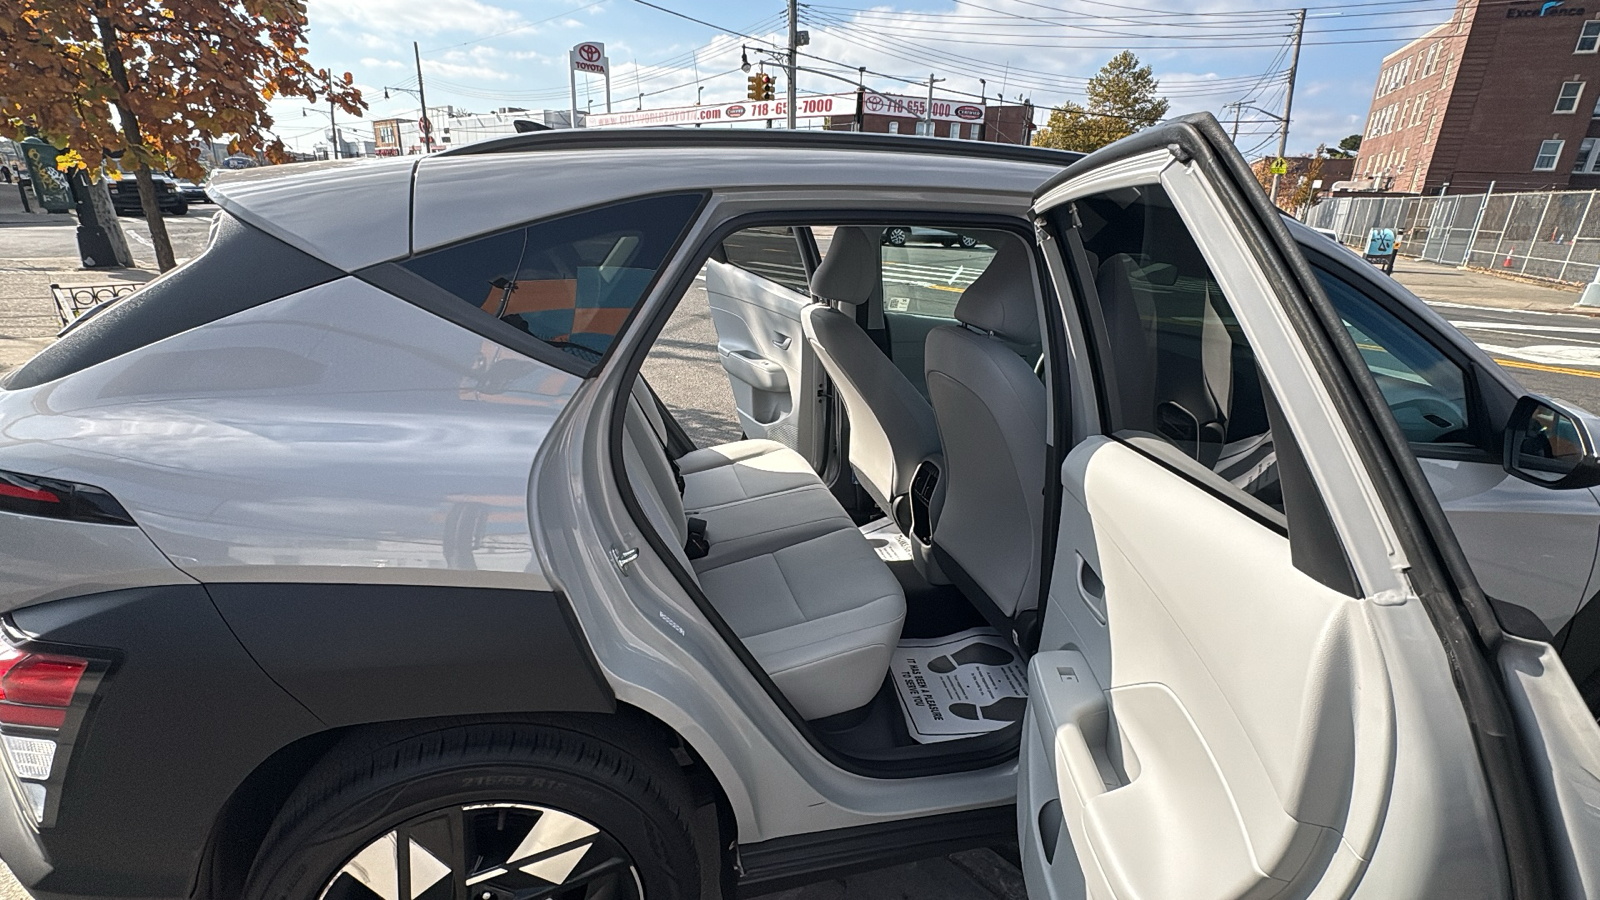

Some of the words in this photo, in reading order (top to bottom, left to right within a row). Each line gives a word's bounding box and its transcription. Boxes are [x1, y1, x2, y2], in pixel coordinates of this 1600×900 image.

[575, 61, 605, 73] TOYOTA
[909, 664, 922, 675] HAS
[914, 675, 928, 689] BEEN
[904, 679, 920, 694] SERVE
[912, 696, 925, 706] YOU
[923, 694, 944, 721] PLEASURE
